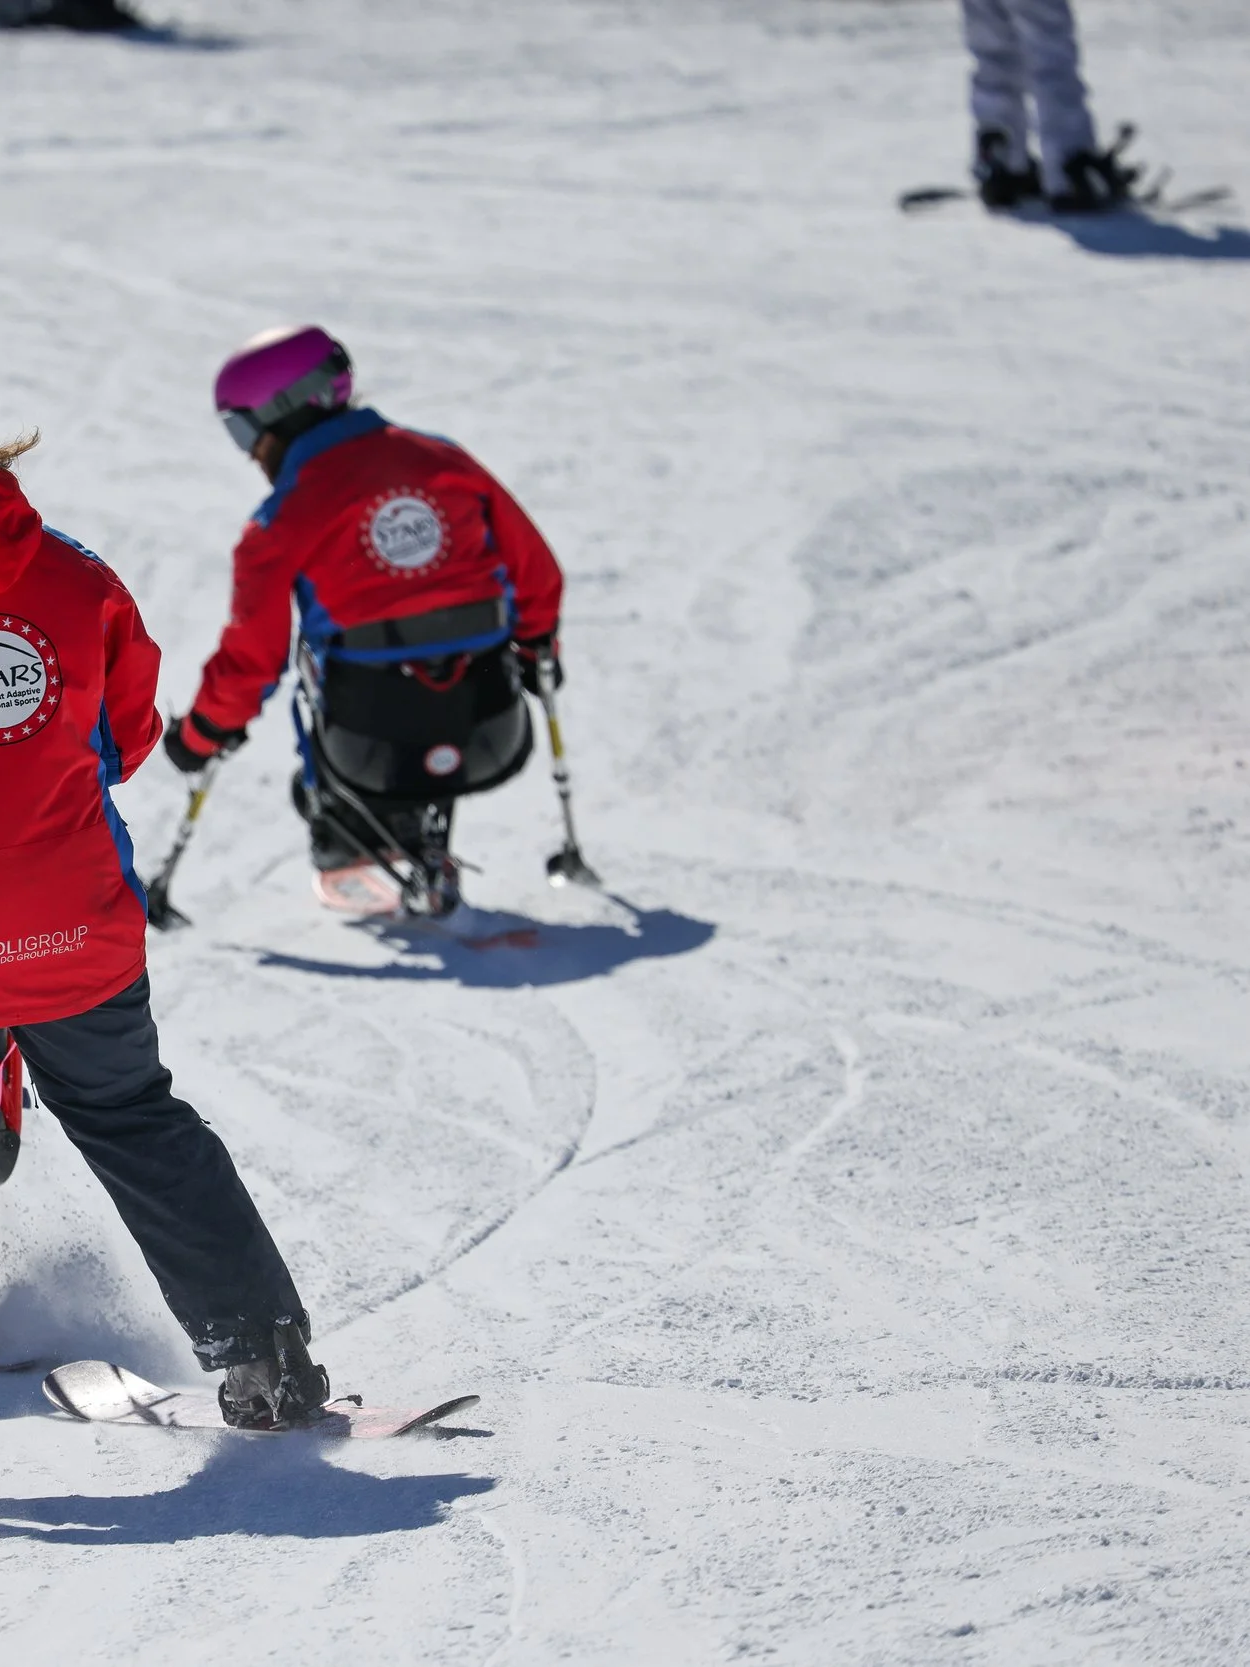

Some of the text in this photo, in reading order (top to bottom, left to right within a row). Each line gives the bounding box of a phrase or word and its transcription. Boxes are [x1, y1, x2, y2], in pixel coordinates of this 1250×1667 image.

[6, 687, 41, 699] Adaptive
[14, 696, 40, 708] Sports
[16, 950, 51, 961] GROUP
[52, 941, 86, 955] REALTY
